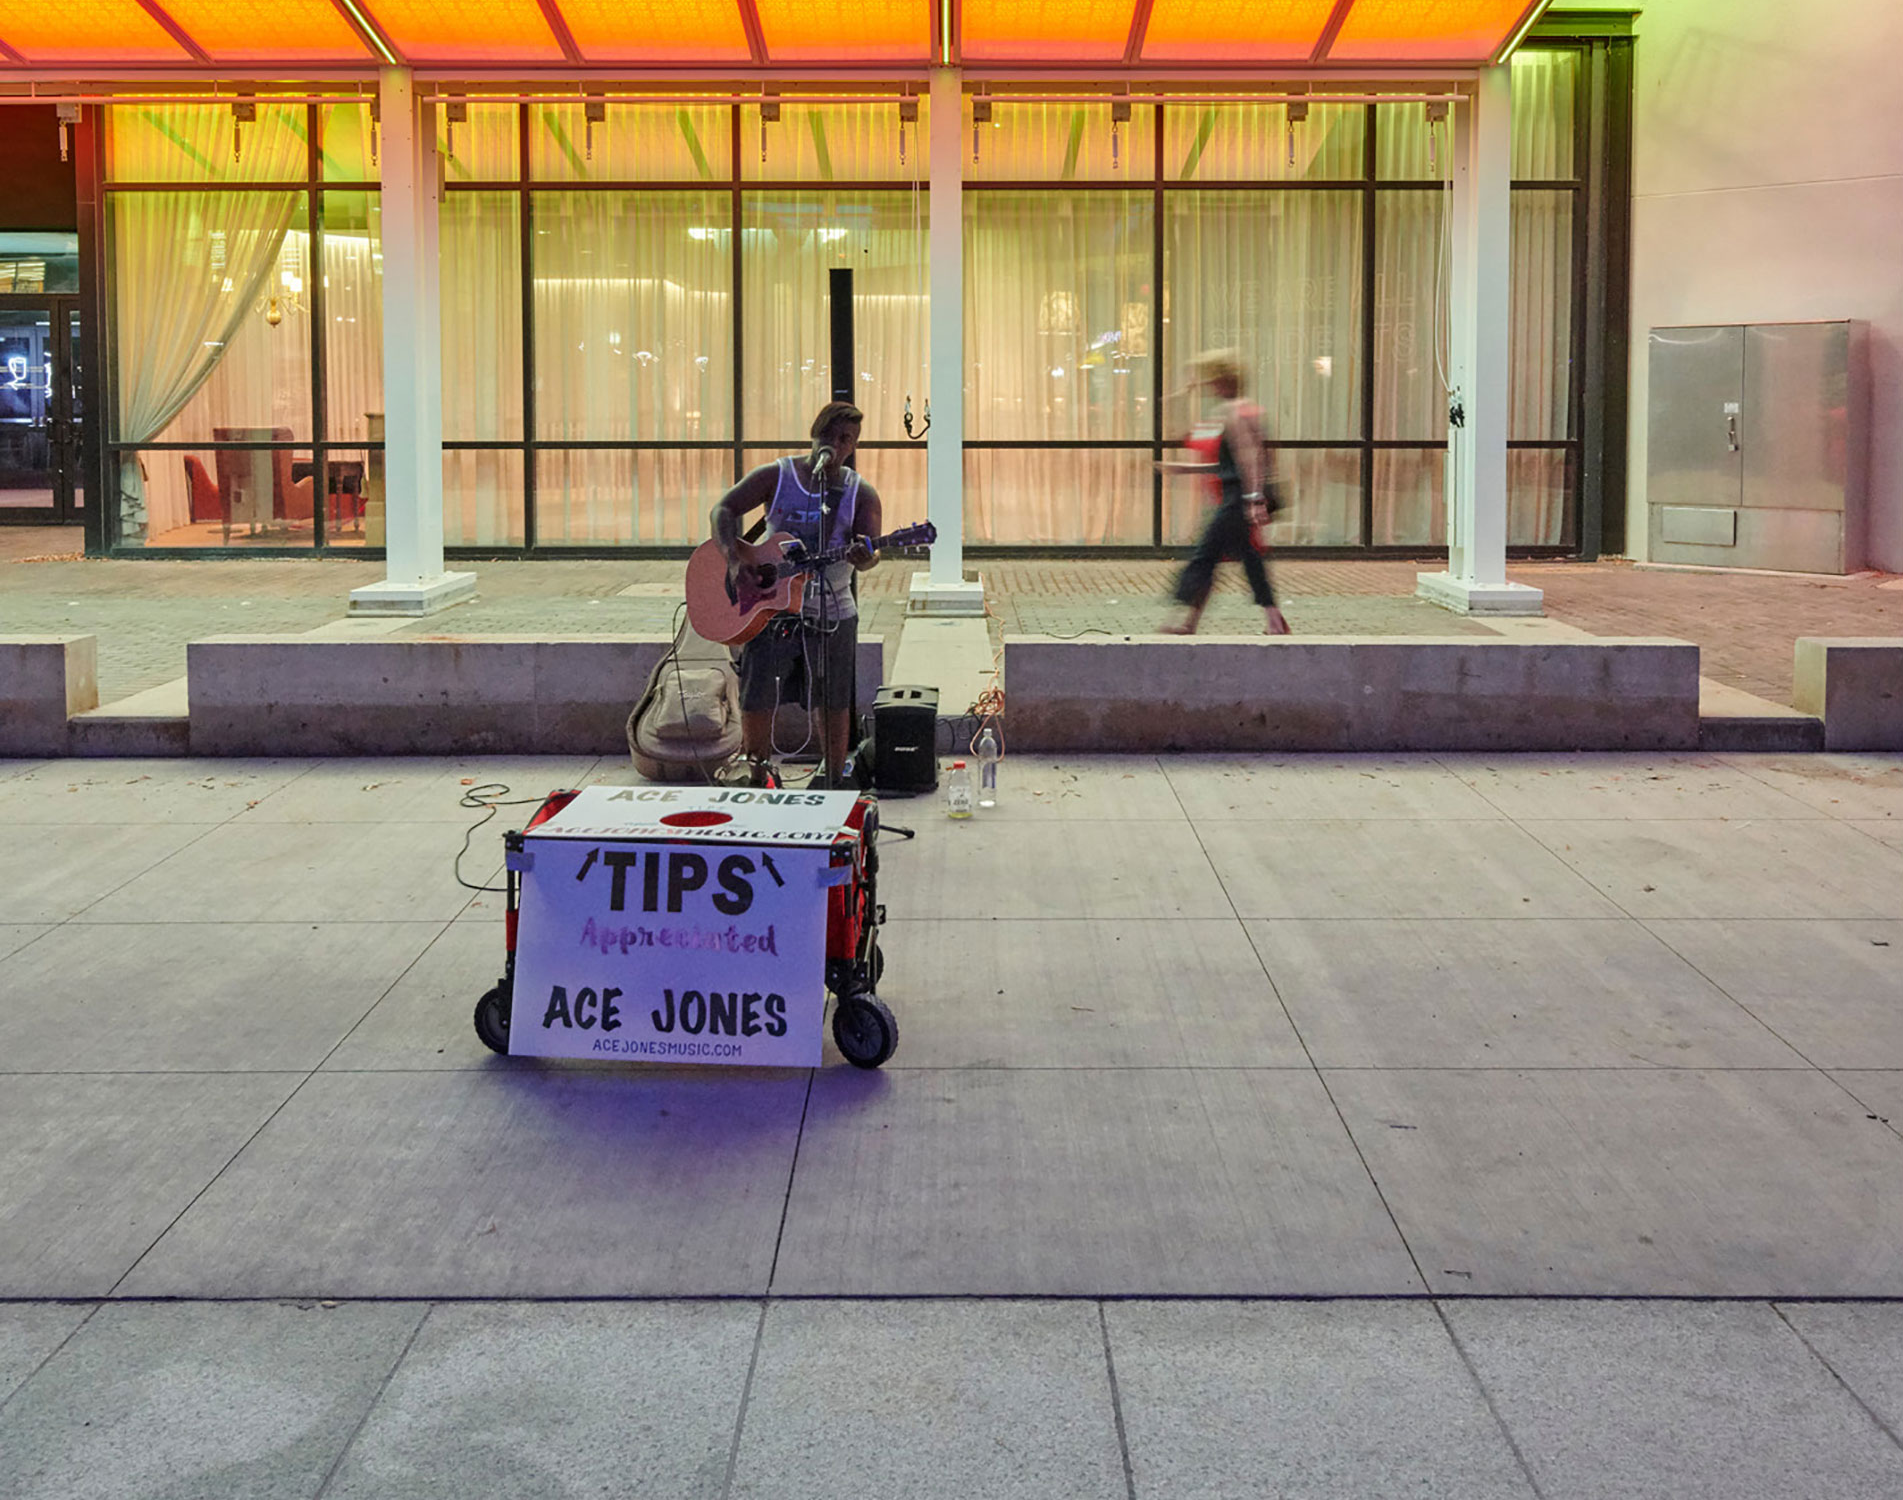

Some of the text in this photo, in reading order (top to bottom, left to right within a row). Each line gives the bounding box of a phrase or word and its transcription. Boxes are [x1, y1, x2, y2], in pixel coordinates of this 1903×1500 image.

[607, 789, 826, 806] ACE JONES
[603, 851, 756, 916] TIPS
[580, 917, 778, 956] Appreciated
[542, 985, 788, 1037] ACE JONES
[592, 1039, 742, 1057] ACEJONESMUSIC.COM
